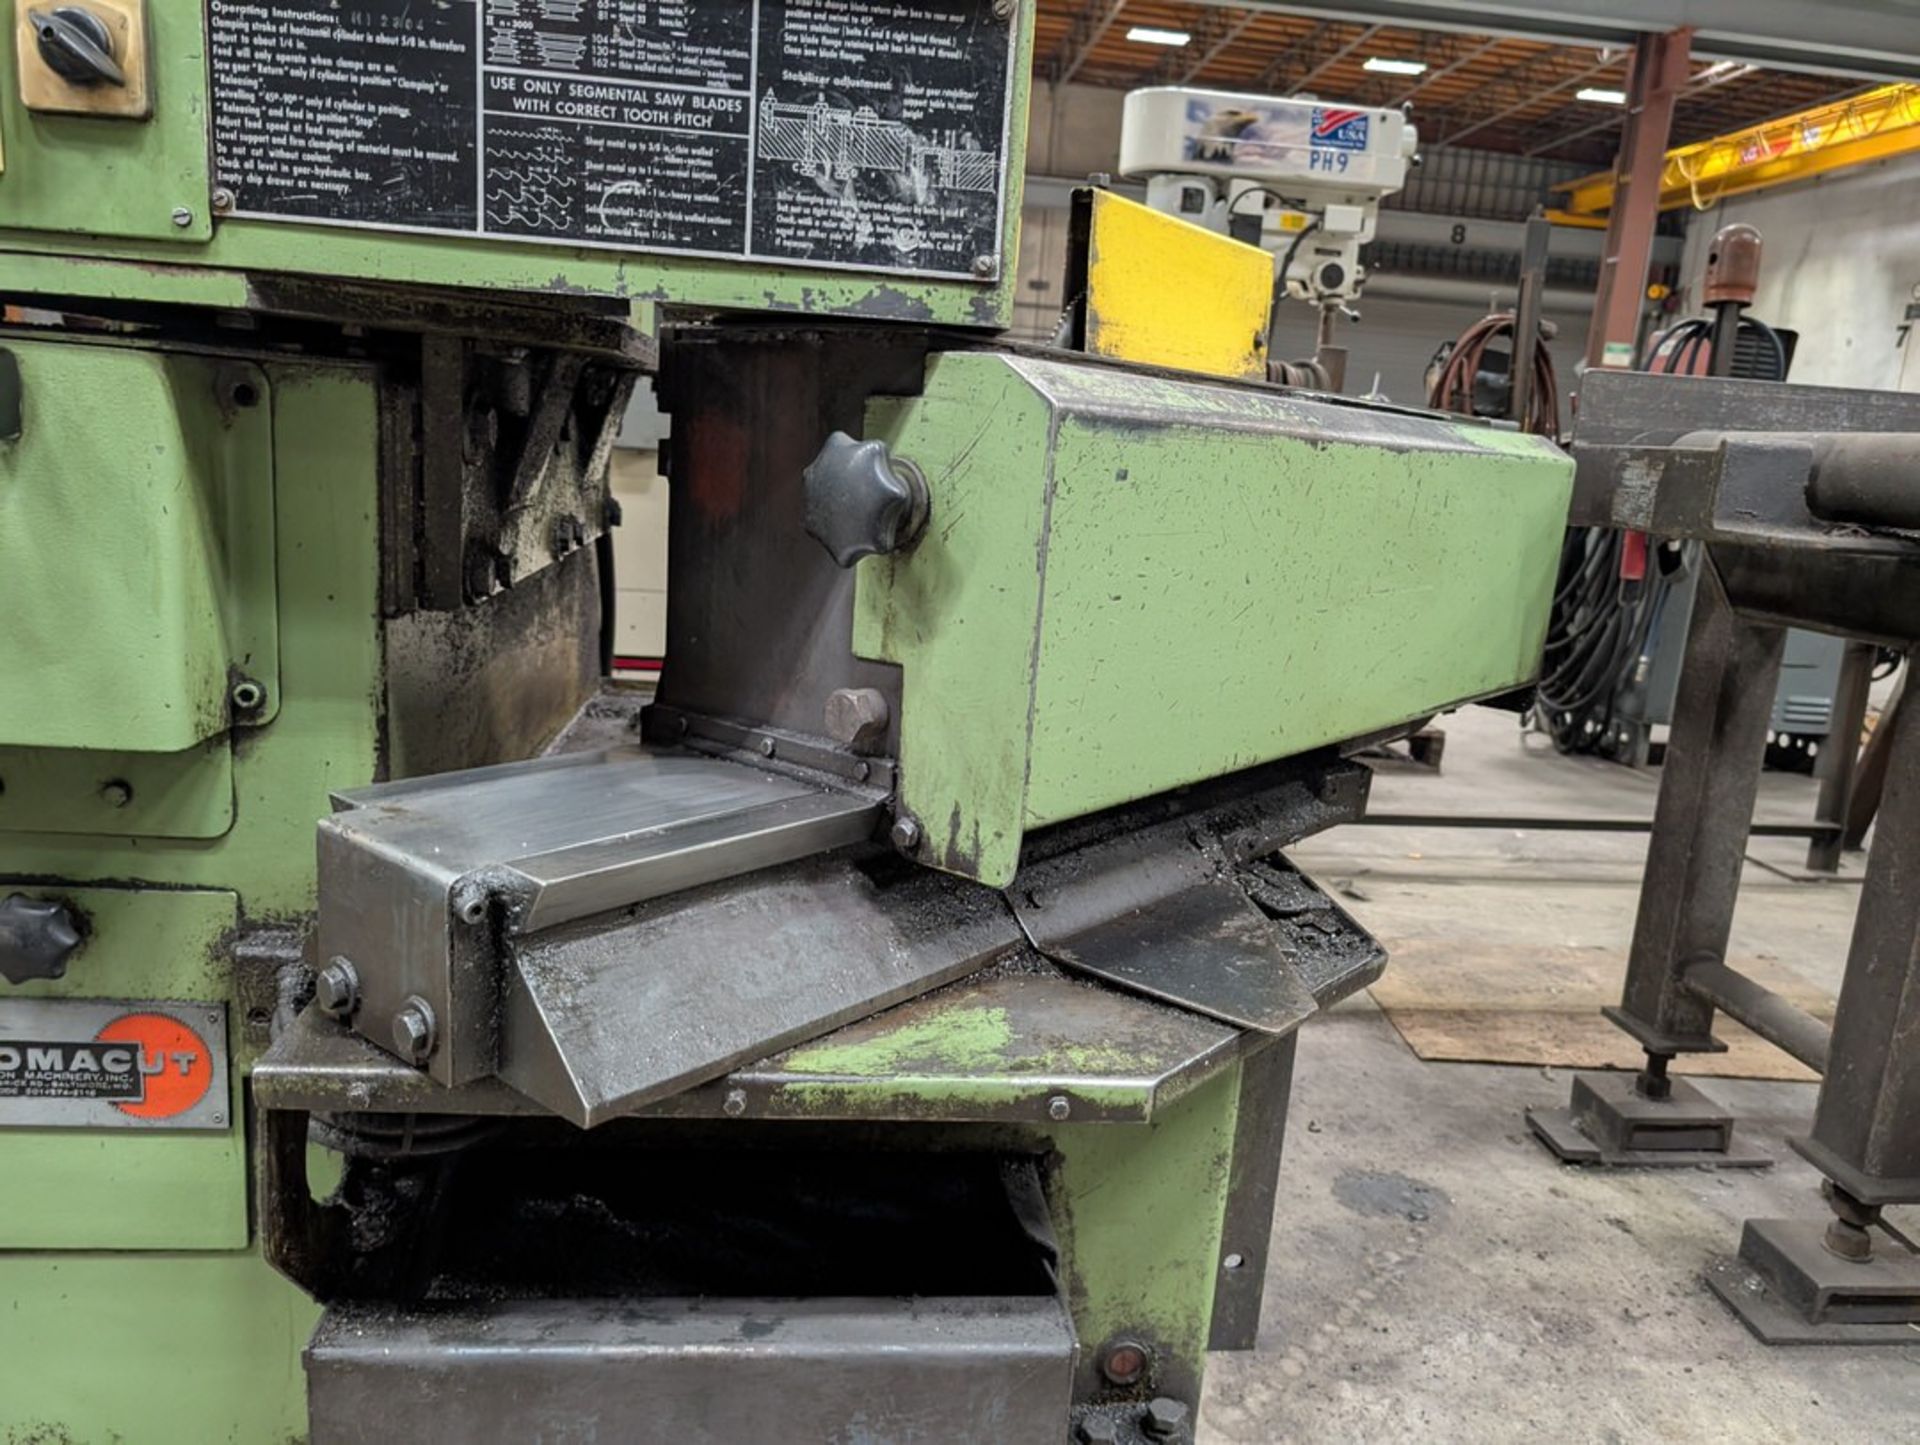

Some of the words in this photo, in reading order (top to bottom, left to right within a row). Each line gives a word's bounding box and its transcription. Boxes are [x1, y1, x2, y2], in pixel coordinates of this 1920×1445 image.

[211, 0, 268, 19] Operating
[272, 6, 339, 24] Instructions:
[212, 30, 237, 45] adjust
[241, 34, 249, 44] to
[253, 35, 276, 47] about
[279, 36, 293, 48] 1/4
[296, 38, 308, 50] in.
[213, 44, 232, 57] Feed
[236, 47, 250, 58] will
[254, 49, 272, 63] only
[276, 53, 306, 64] operate
[311, 54, 333, 66] when
[336, 57, 363, 72] clamps
[367, 62, 381, 72] are
[384, 64, 398, 74] on.
[213, 58, 230, 70] Saw
[232, 62, 250, 74] gear
[290, 66, 308, 81] only
[310, 67, 315, 79] if
[317, 69, 349, 83] cylinder
[350, 72, 358, 83] in
[360, 75, 392, 87] position
[440, 84, 449, 93] or
[782, 69, 830, 84] Stabilizer
[305, 96, 322, 110] only
[325, 96, 331, 108] if
[333, 98, 365, 113] cylinder
[367, 102, 376, 112] in
[490, 76, 516, 91] USE
[524, 80, 562, 95] ONLY
[569, 84, 649, 104] SEGMENTAL
[655, 91, 685, 107] SAW
[692, 96, 743, 113] BLADES
[268, 106, 283, 117] and
[286, 106, 304, 119] feed
[305, 109, 314, 119] in
[316, 111, 348, 124] position
[513, 97, 550, 112] WITH
[556, 101, 617, 119] CORRECT
[623, 108, 669, 124] TOOTH
[674, 111, 712, 128] PITCH
[216, 115, 241, 129] Adjust
[244, 117, 262, 129] feed
[266, 121, 289, 133] speed
[293, 124, 302, 133] at
[305, 122, 323, 135] feed
[1338, 129, 1365, 143] USA
[216, 143, 227, 154] Do
[232, 146, 246, 155] not
[250, 148, 264, 157] cut
[268, 147, 299, 160] without
[302, 151, 333, 164] coolant.
[1310, 150, 1348, 173] PH9
[1451, 224, 1466, 245] 8
[1896, 324, 1912, 349] 7
